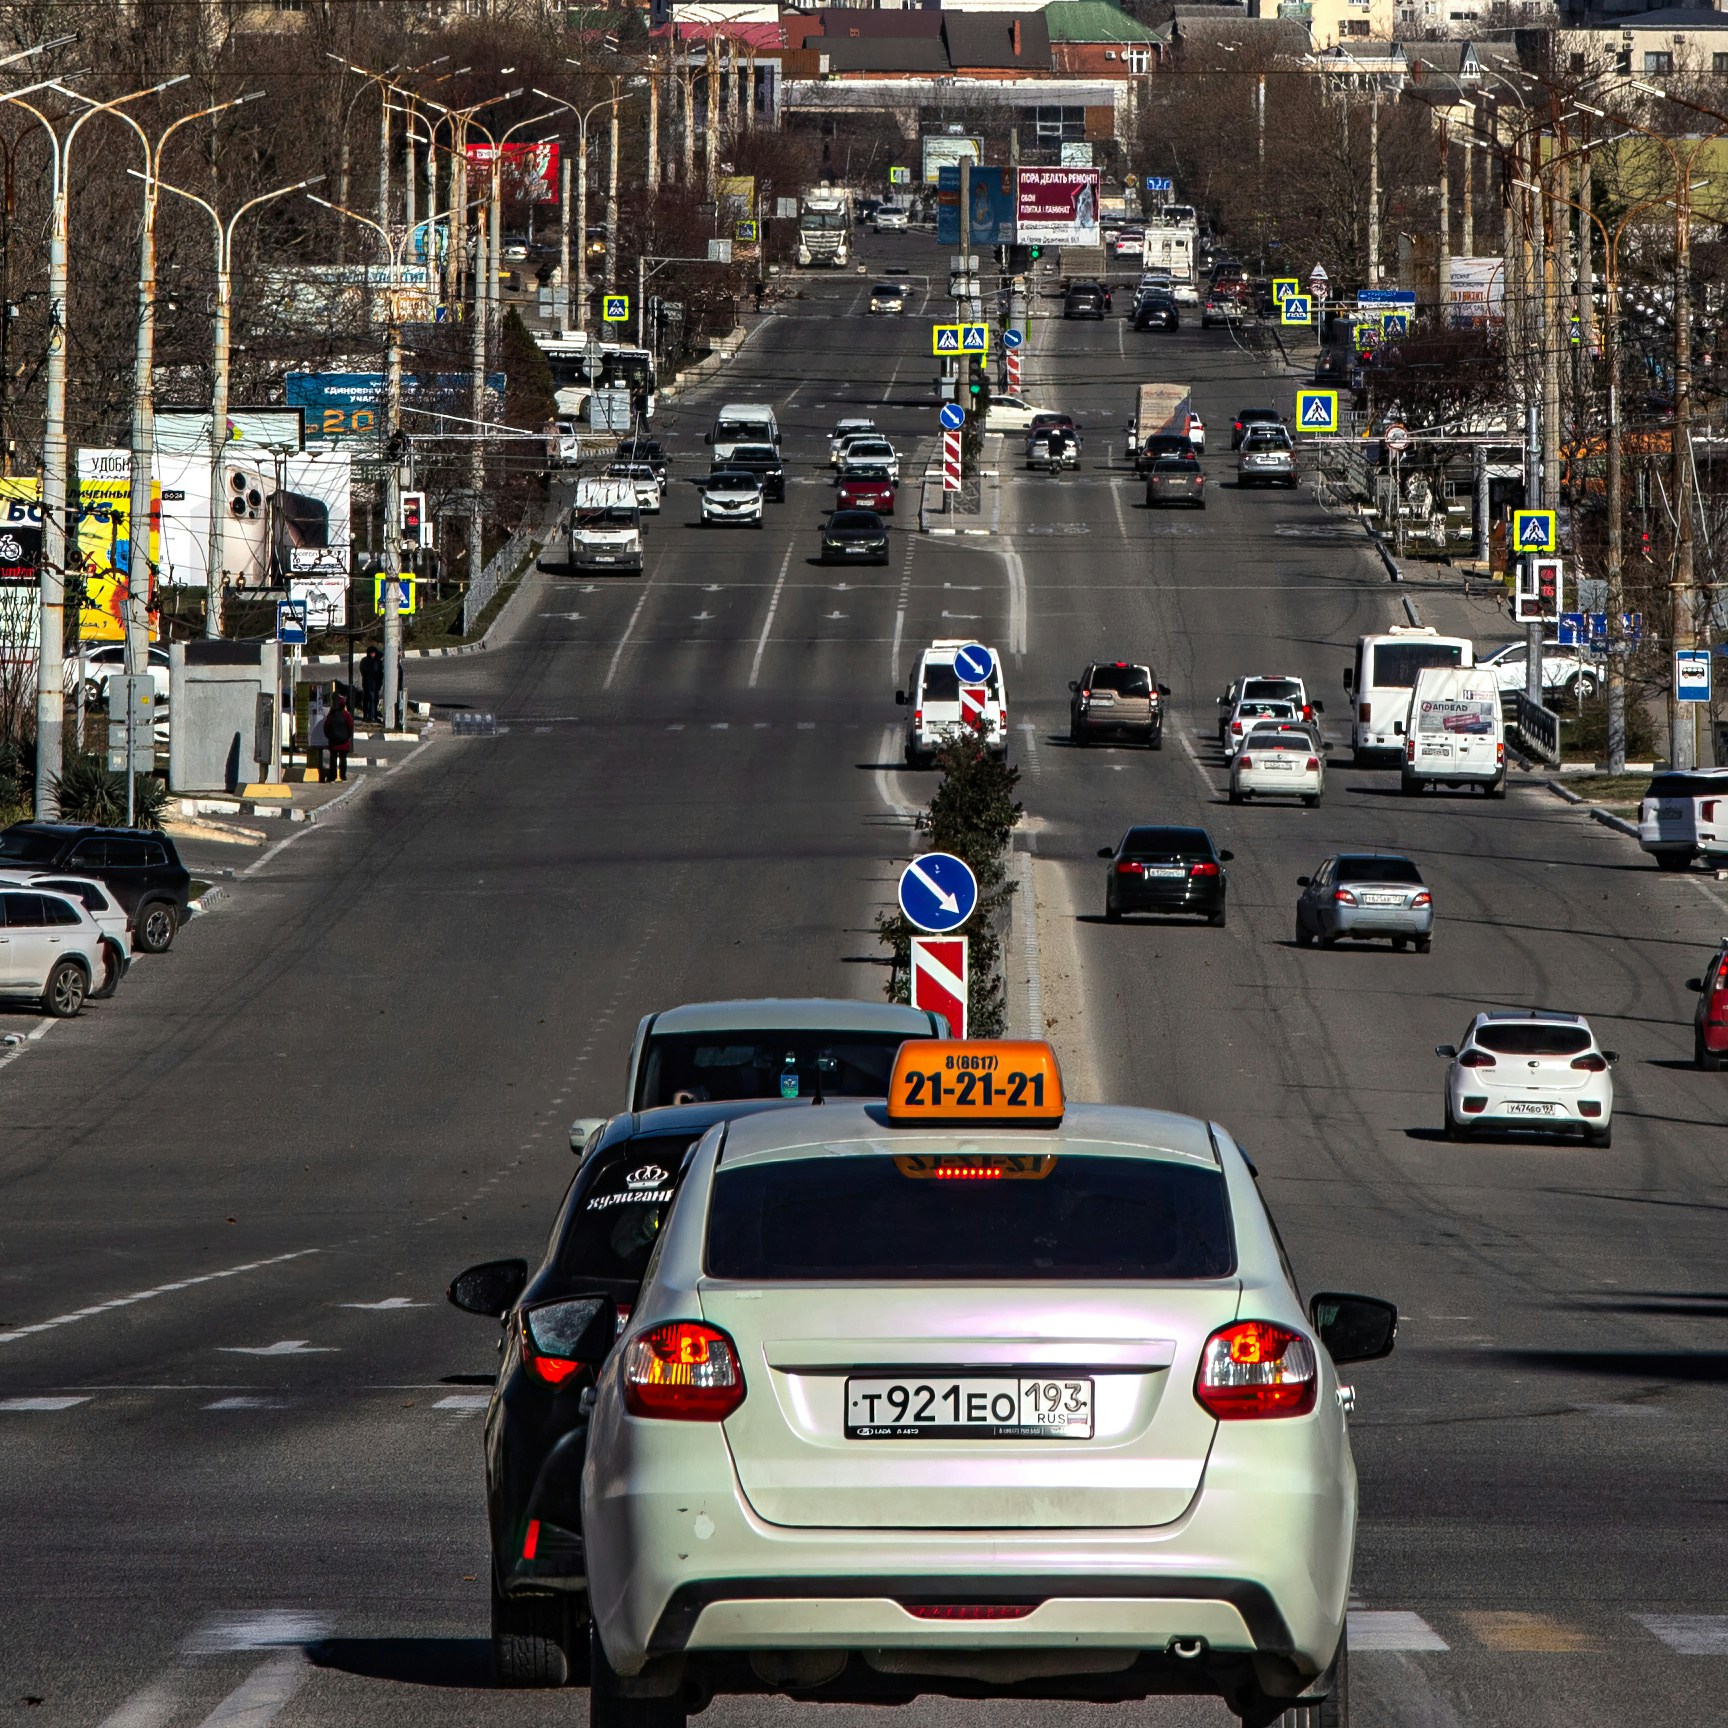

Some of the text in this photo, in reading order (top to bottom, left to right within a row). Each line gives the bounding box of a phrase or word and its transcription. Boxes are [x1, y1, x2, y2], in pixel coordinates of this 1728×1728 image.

[1021, 173, 1098, 186] ПОРА ДЕЛАТЬ РЕМОНТ!
[945, 1055, 999, 1071] 8(8617)
[905, 1070, 1044, 1107] 21-21-21
[862, 1383, 1082, 1423] Т921ЕО 193
[1037, 1413, 1067, 1424] RUS
